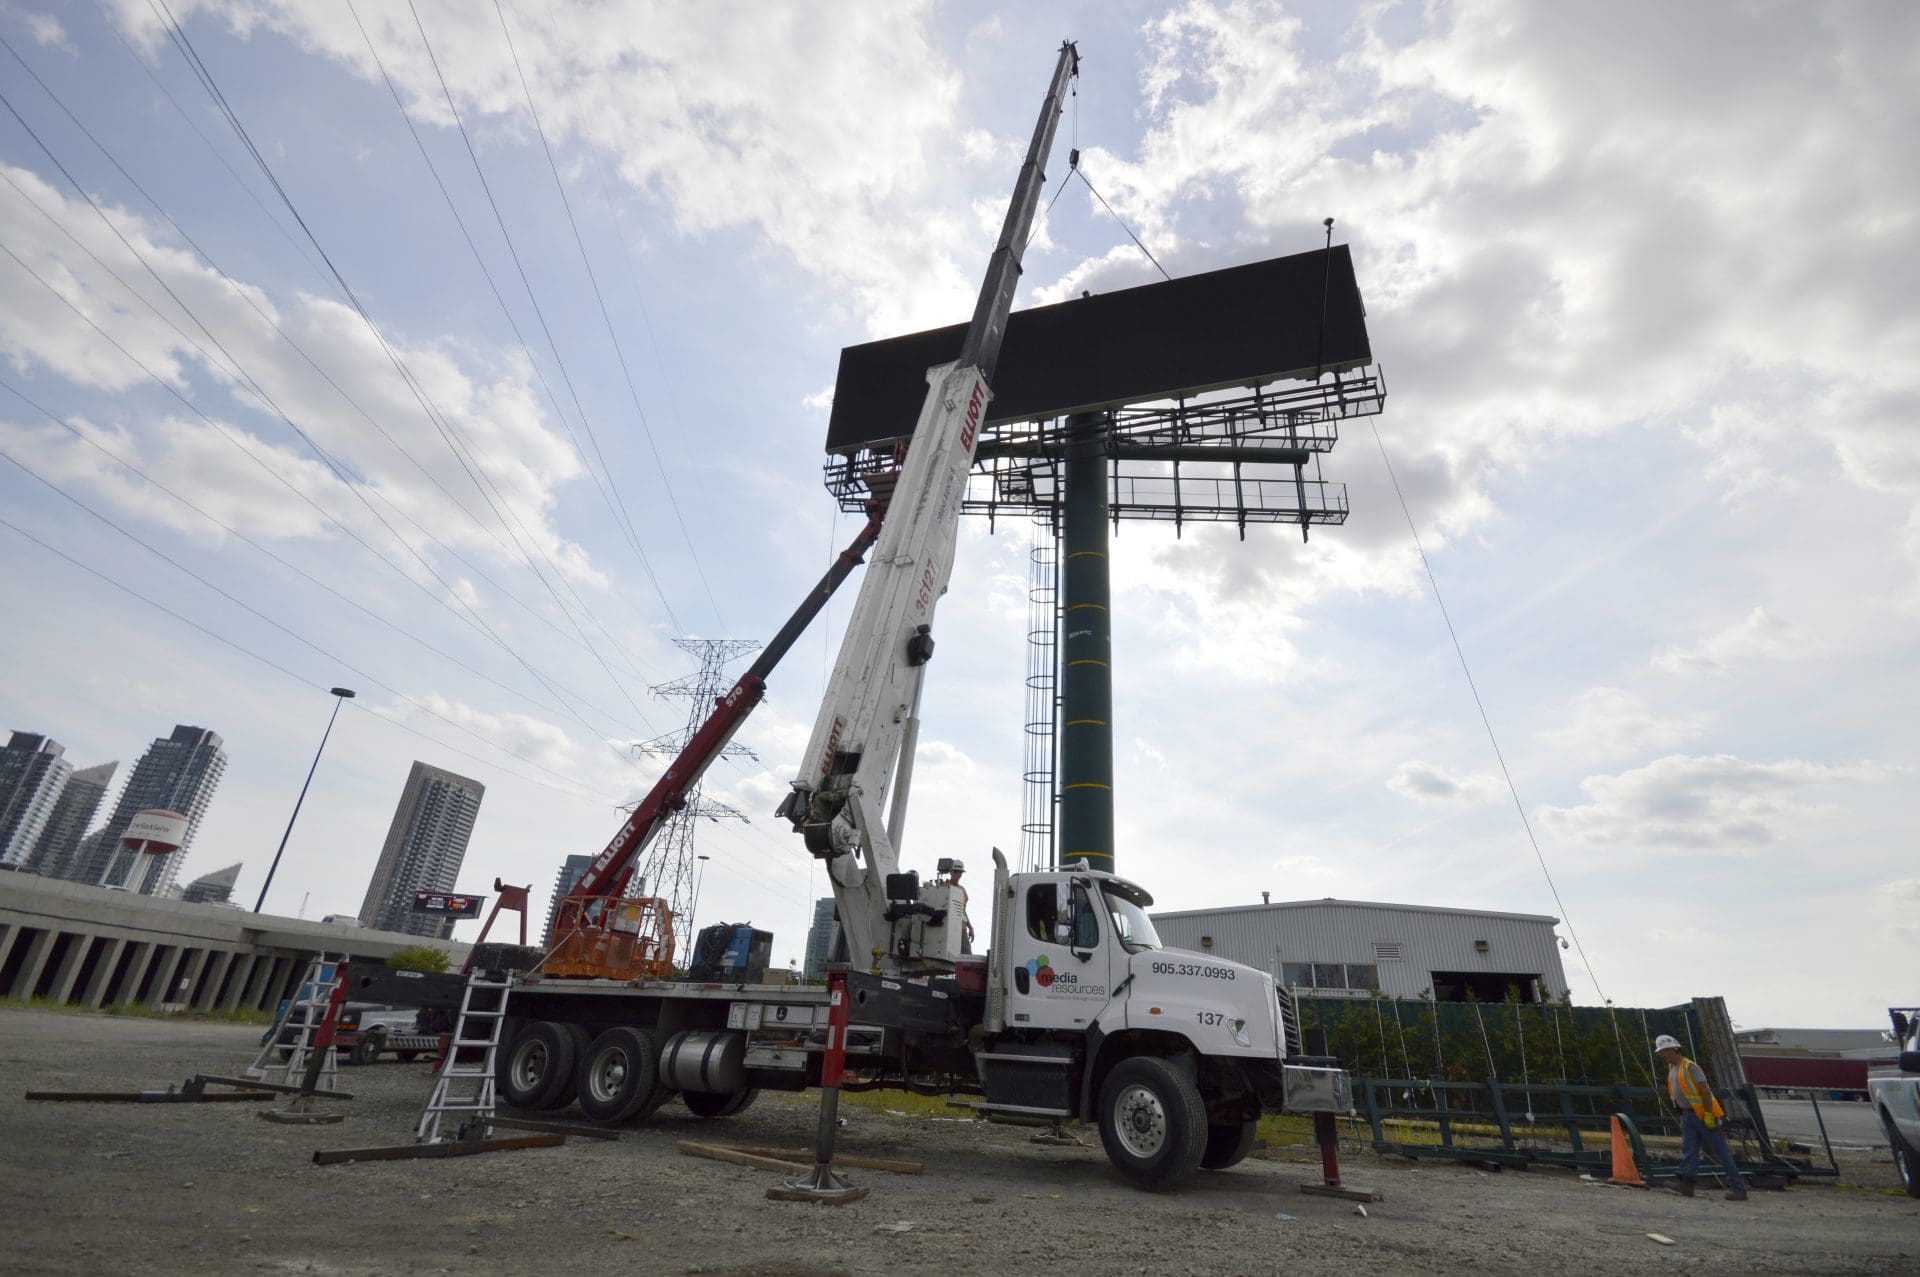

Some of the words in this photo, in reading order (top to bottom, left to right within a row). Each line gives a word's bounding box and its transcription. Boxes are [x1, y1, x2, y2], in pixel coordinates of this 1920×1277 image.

[960, 379, 984, 453] ELLIOTT
[915, 558, 937, 616] 36127
[595, 820, 636, 872] ELLIOTT
[1041, 972, 1078, 984] media
[1152, 962, 1236, 980] 905.337.0993
[1051, 983, 1105, 995] resources
[1197, 1011, 1224, 1026] 137
